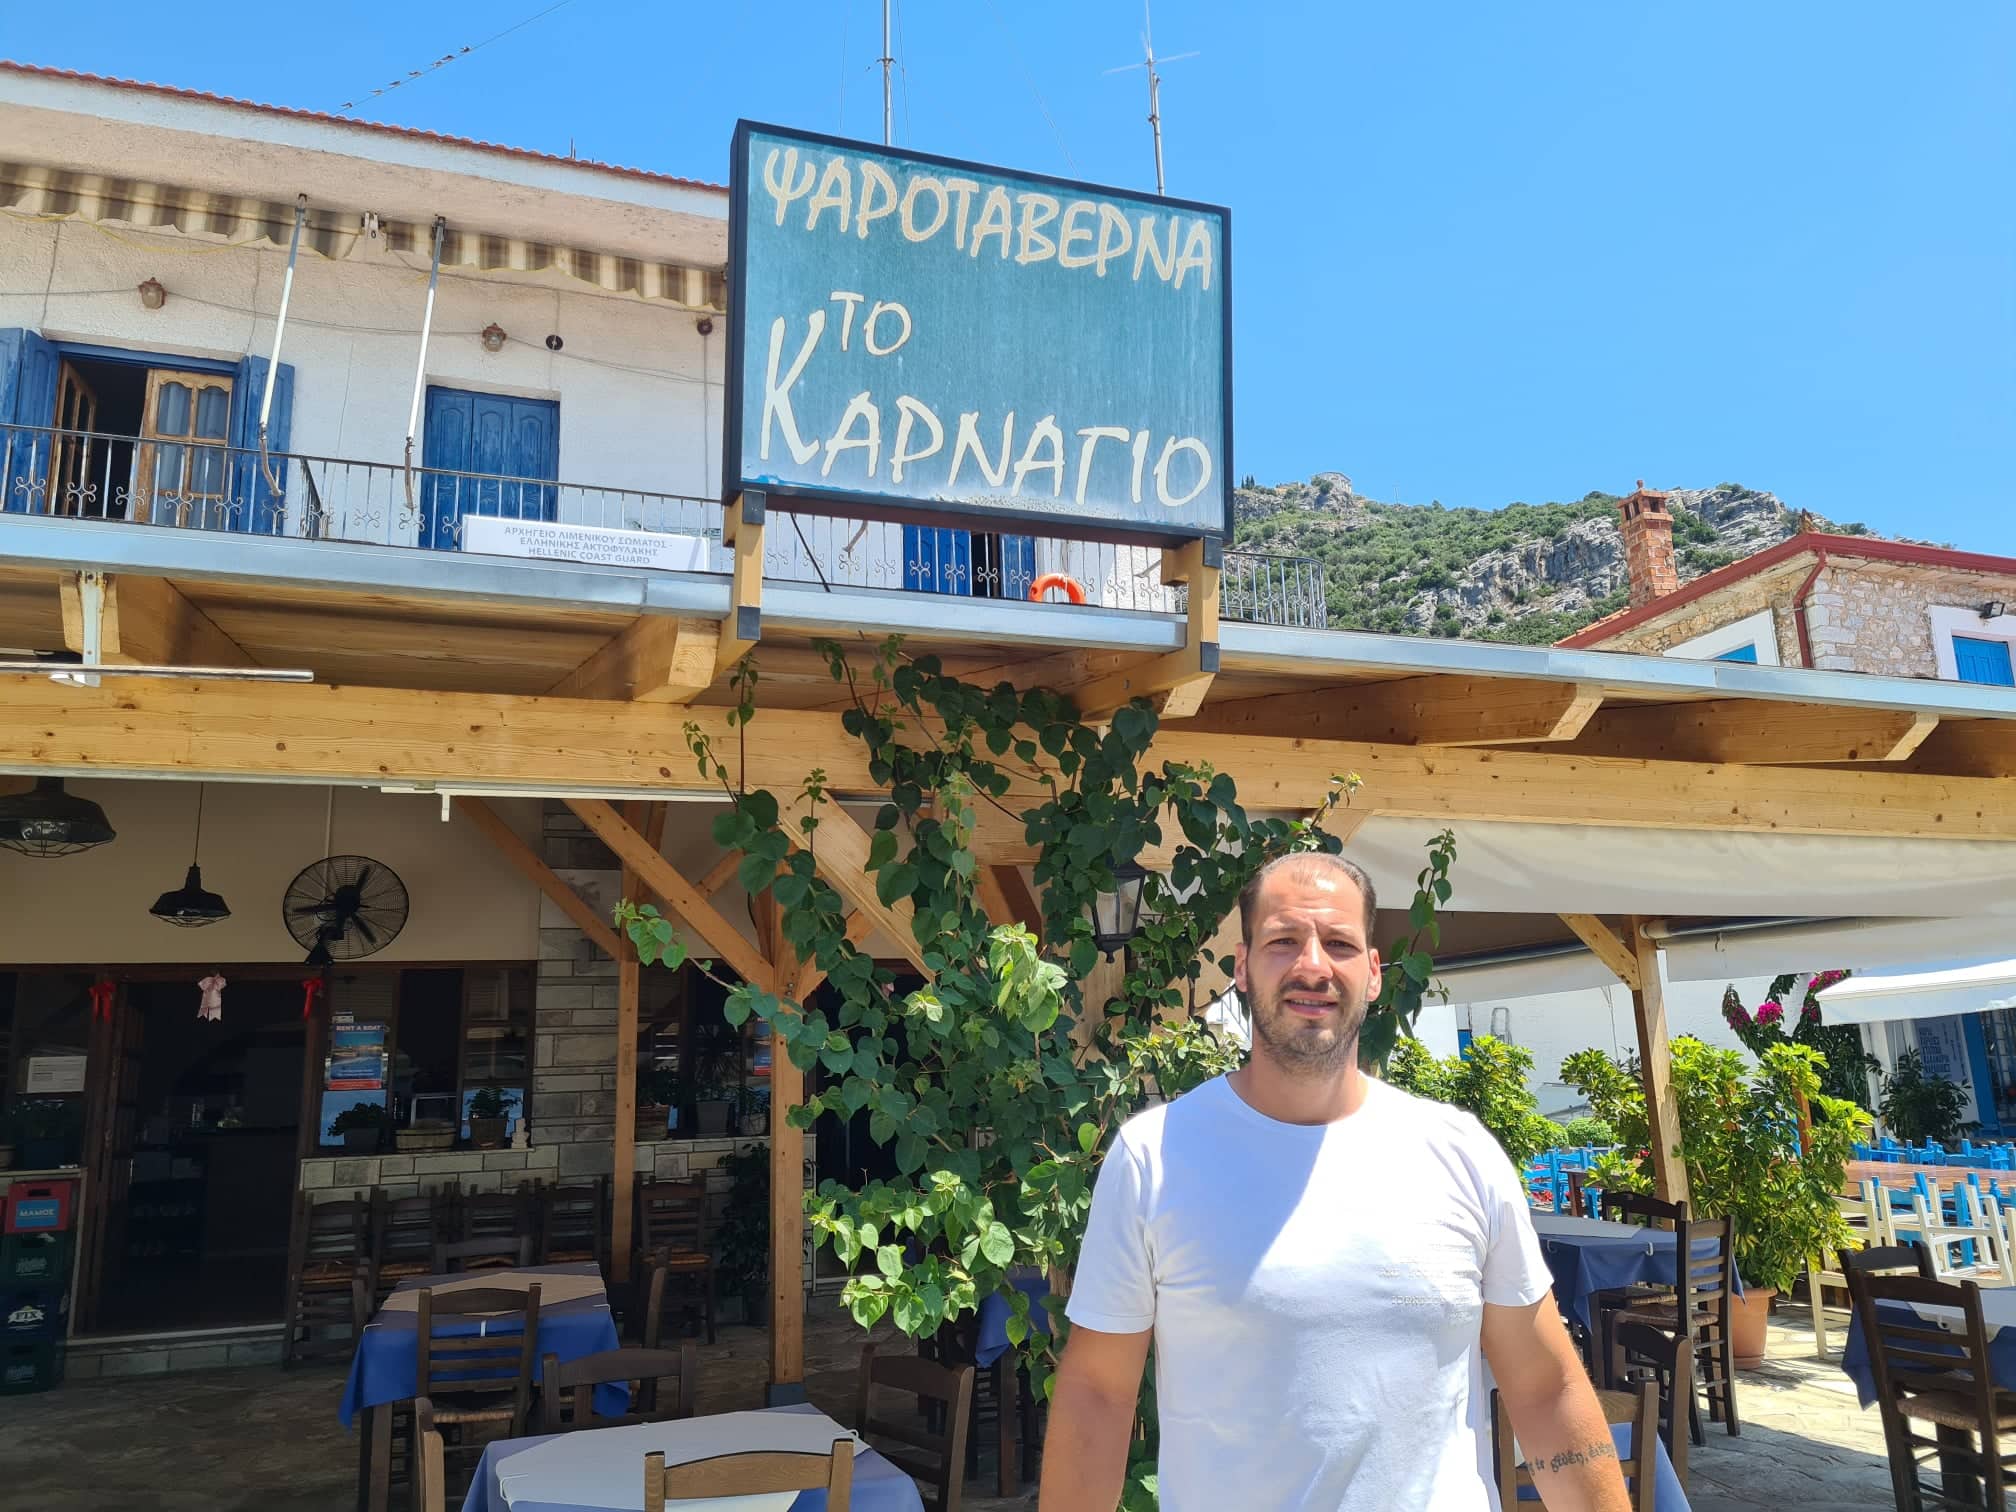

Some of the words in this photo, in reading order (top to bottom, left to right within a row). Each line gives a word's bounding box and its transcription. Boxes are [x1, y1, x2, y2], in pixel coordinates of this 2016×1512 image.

[763, 147, 1213, 290] ΨΑΡΟΤΑΒΕΡΝΑ
[830, 291, 912, 356] ΤΟ
[760, 309, 1213, 507] ΚΑΡΝΑΓΙΟ
[504, 525, 556, 539] ΑΡΧΗΓΕΙΟ
[559, 531, 616, 545] ΛΙΜΕΝΙΚΟΥ
[520, 536, 580, 550] ΕΛΛΗΝΙΚΗΣ
[582, 542, 658, 557] ΑΚΤΟΦΥΛΑΚΗΣ
[528, 547, 577, 560] HELLENIC
[579, 551, 613, 563] COAST
[615, 553, 651, 565] GUARD
